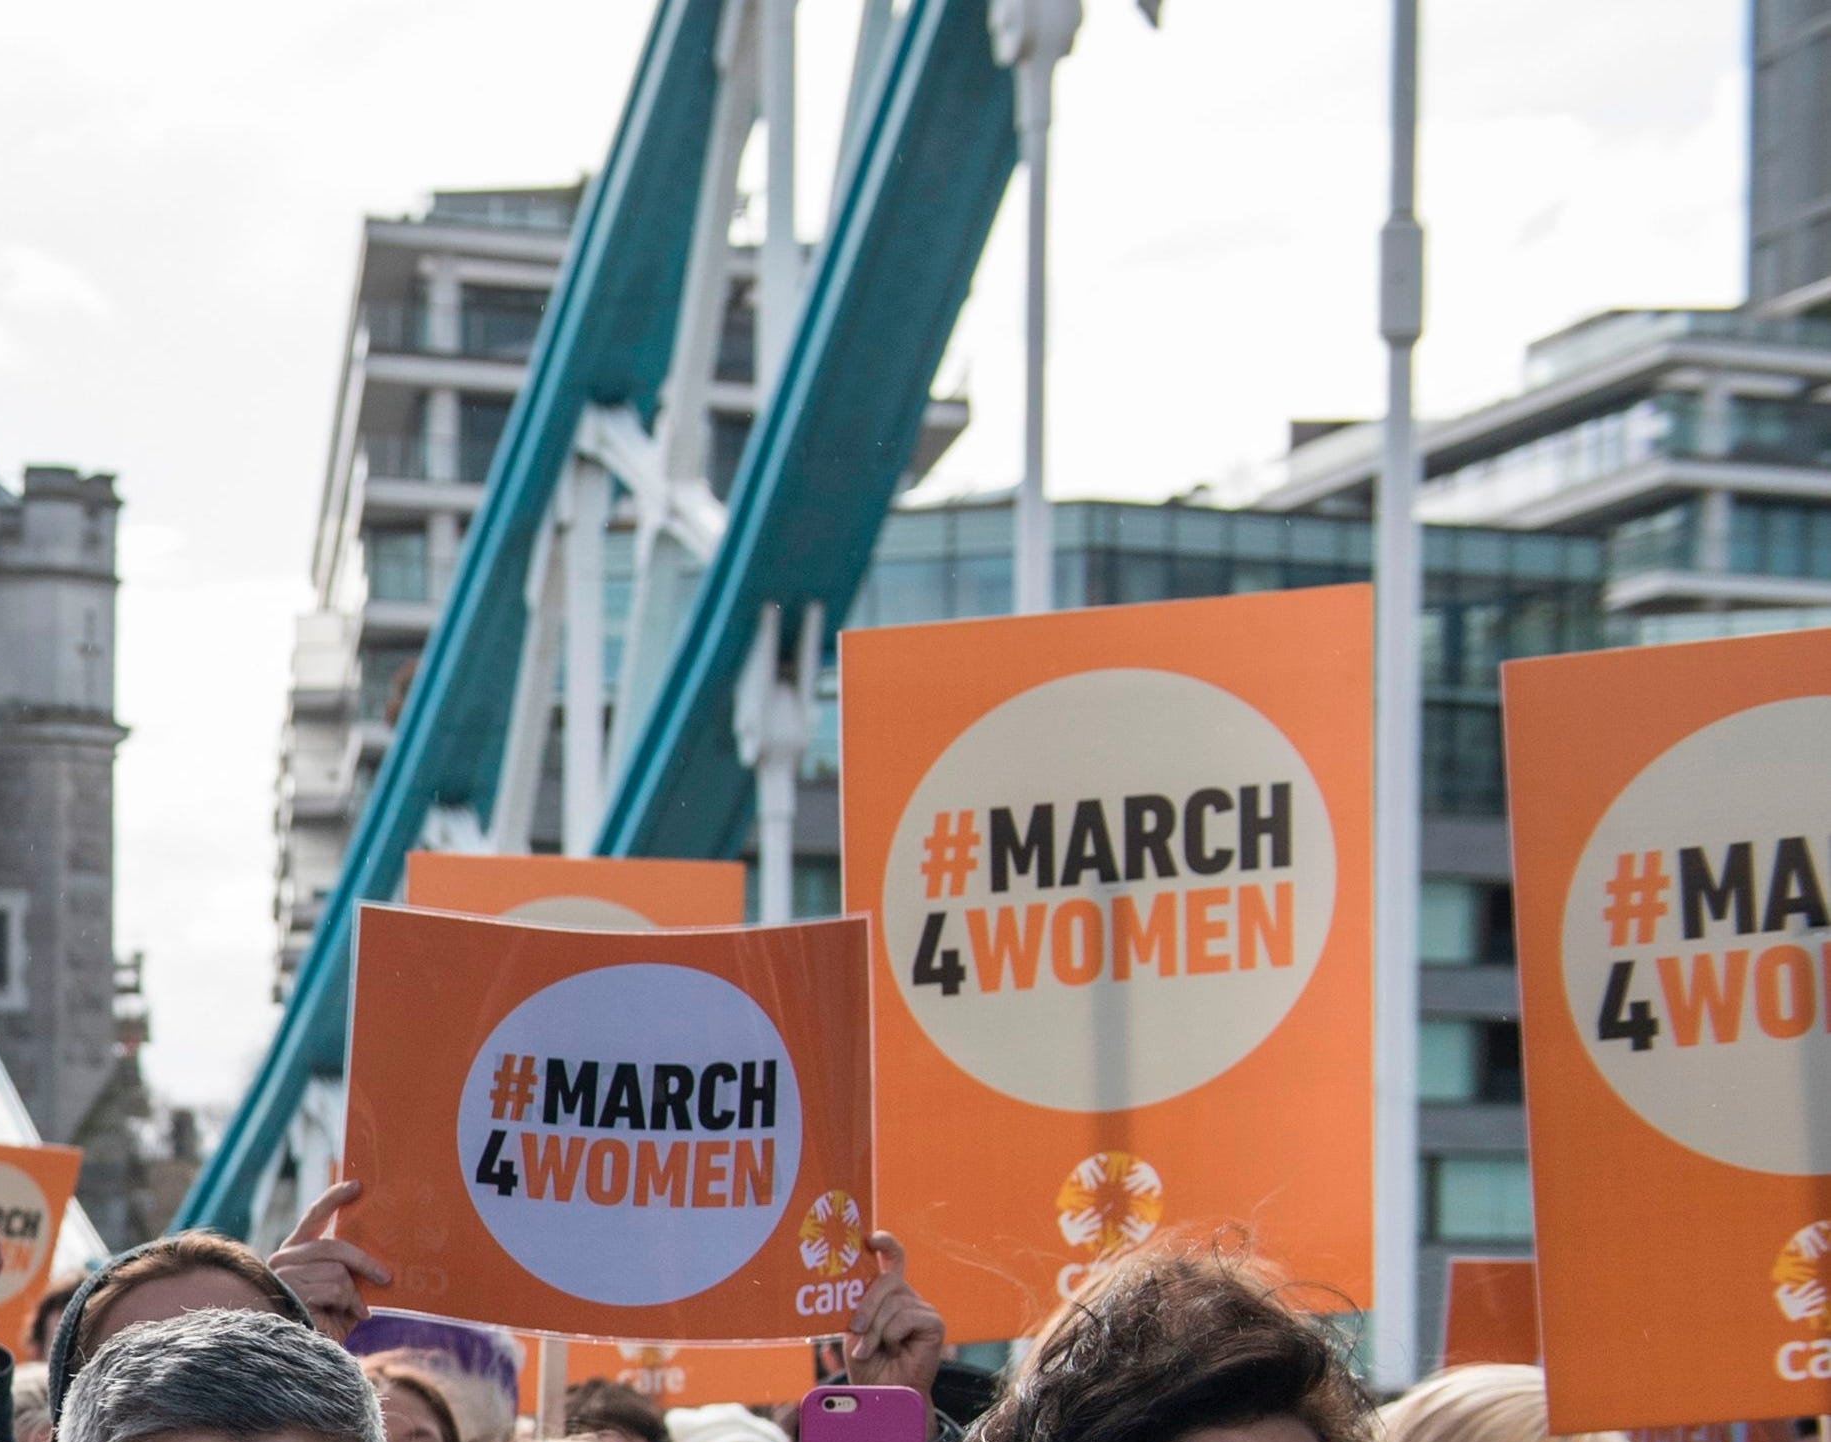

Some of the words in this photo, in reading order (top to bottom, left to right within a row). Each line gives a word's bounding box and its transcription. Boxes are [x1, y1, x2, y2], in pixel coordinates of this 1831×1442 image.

[920, 781, 1294, 900] #MARCH
[912, 880, 1296, 997] 4WOMEN
[1597, 942, 1831, 1052] 4WO
[489, 1052, 778, 1132] #MARCH
[474, 1129, 777, 1210] 4WOMEN
[795, 1277, 864, 1317] care
